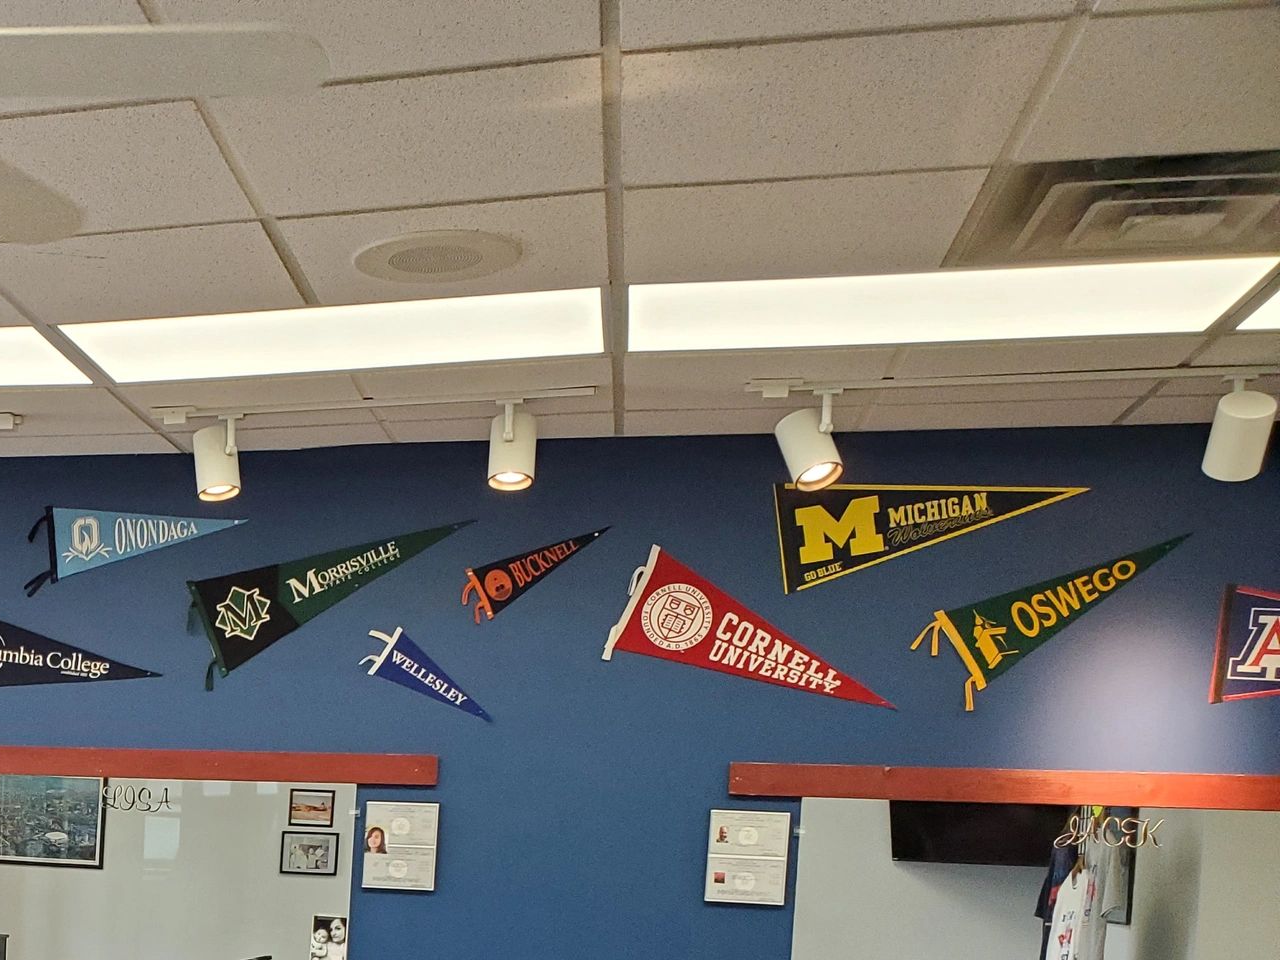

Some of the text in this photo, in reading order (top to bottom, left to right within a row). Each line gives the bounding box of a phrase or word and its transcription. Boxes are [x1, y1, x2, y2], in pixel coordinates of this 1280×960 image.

[795, 495, 885, 564] M
[888, 492, 988, 527] MICHIGAN
[115, 518, 198, 554] ONONDAGA
[286, 541, 399, 604] MORRISVILLE
[324, 553, 401, 589] STATE COLLEGE
[508, 541, 579, 587] BUCKNELL
[804, 563, 842, 582] GO BLUE
[647, 585, 710, 629] CORNELL UNIVERSITY
[1011, 559, 1136, 638] OSWEGO
[643, 612, 663, 646] FOUNDED
[716, 612, 841, 686] CORNELL
[47, 652, 109, 678] College
[392, 650, 467, 705] WELLESLEY
[709, 640, 836, 692] UNIVERSITY
[102, 785, 172, 812] LISA
[1054, 816, 1164, 848] JACK
